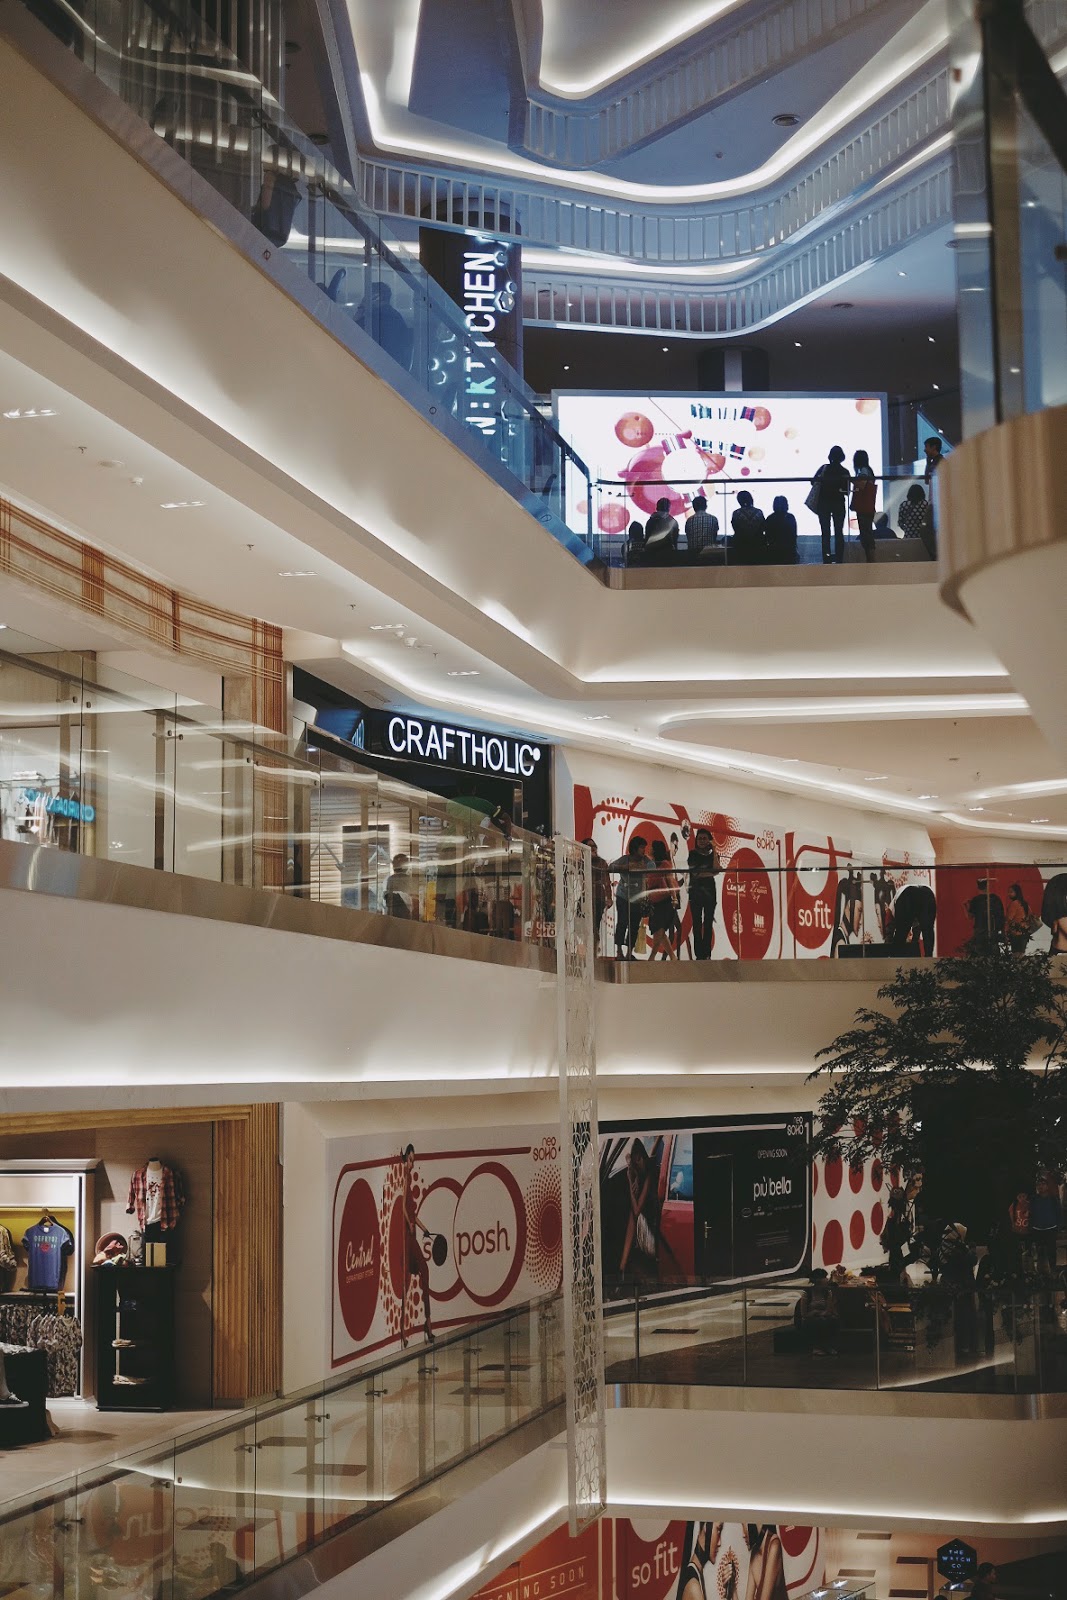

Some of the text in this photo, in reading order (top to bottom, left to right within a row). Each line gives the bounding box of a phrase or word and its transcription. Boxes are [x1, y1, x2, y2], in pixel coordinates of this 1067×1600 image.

[388, 716, 541, 777] CRAFTHOLIC
[756, 837, 776, 851] SOHO
[786, 1123, 804, 1136] SOHO
[541, 1136, 557, 1147] neo
[532, 1145, 558, 1162] SOHO
[768, 1175, 792, 1196] bella
[345, 1234, 374, 1272] Central
[456, 1220, 511, 1266] posh
[550, 1565, 584, 1589] SOON
